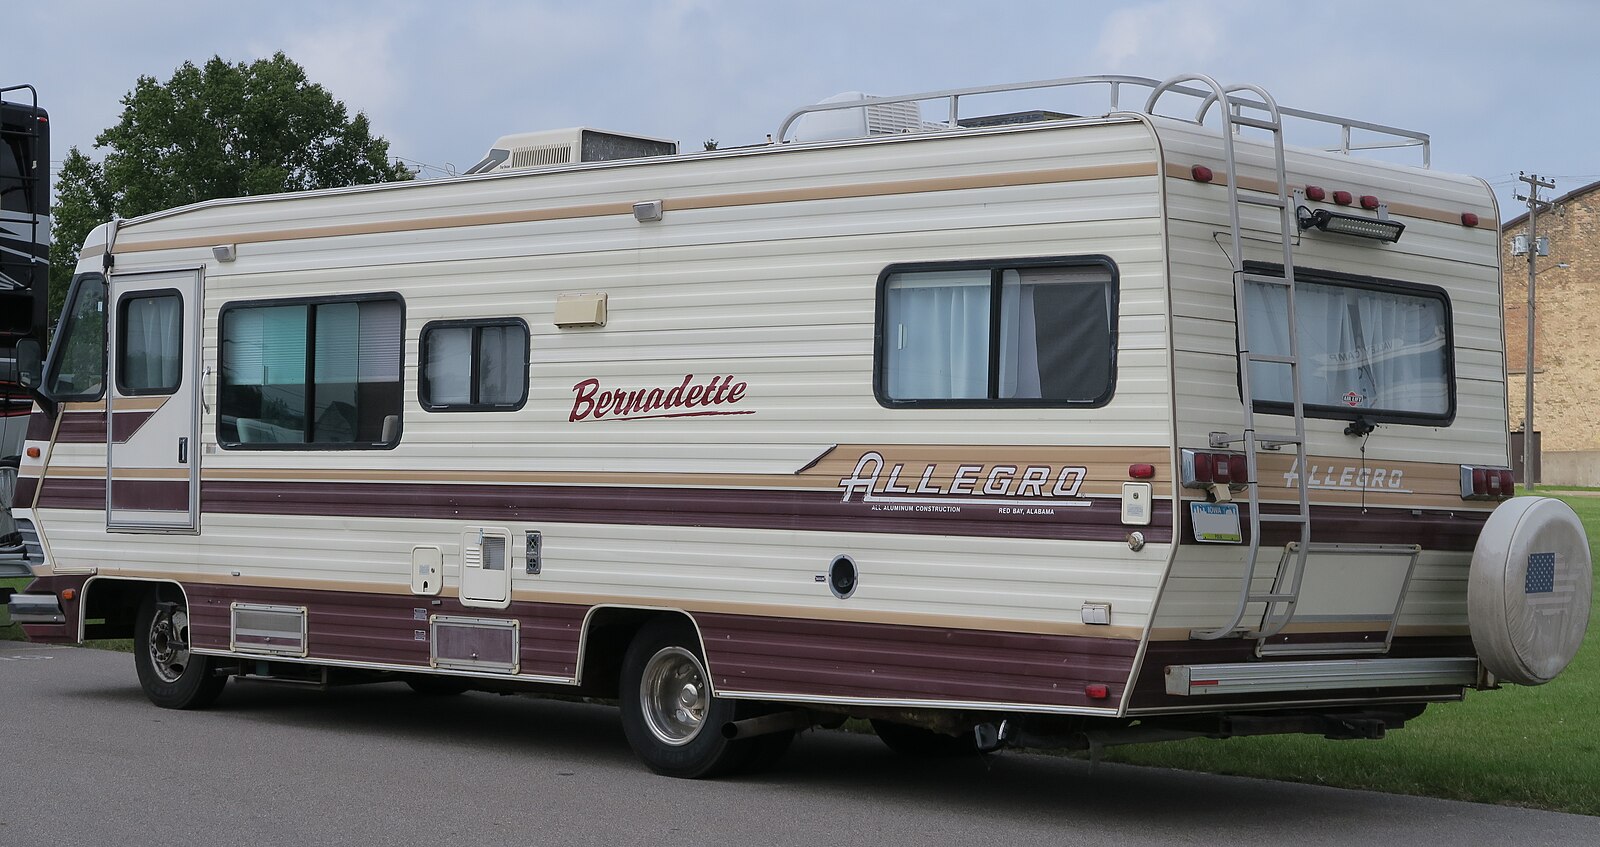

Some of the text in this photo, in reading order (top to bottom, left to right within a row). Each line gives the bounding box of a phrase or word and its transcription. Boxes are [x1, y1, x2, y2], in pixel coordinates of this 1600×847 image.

[568, 374, 748, 422] Bernadette
[838, 451, 1088, 503] ALLEGRO
[915, 505, 961, 513] CONSTRUCTION
[1012, 507, 1025, 515] BAY,
